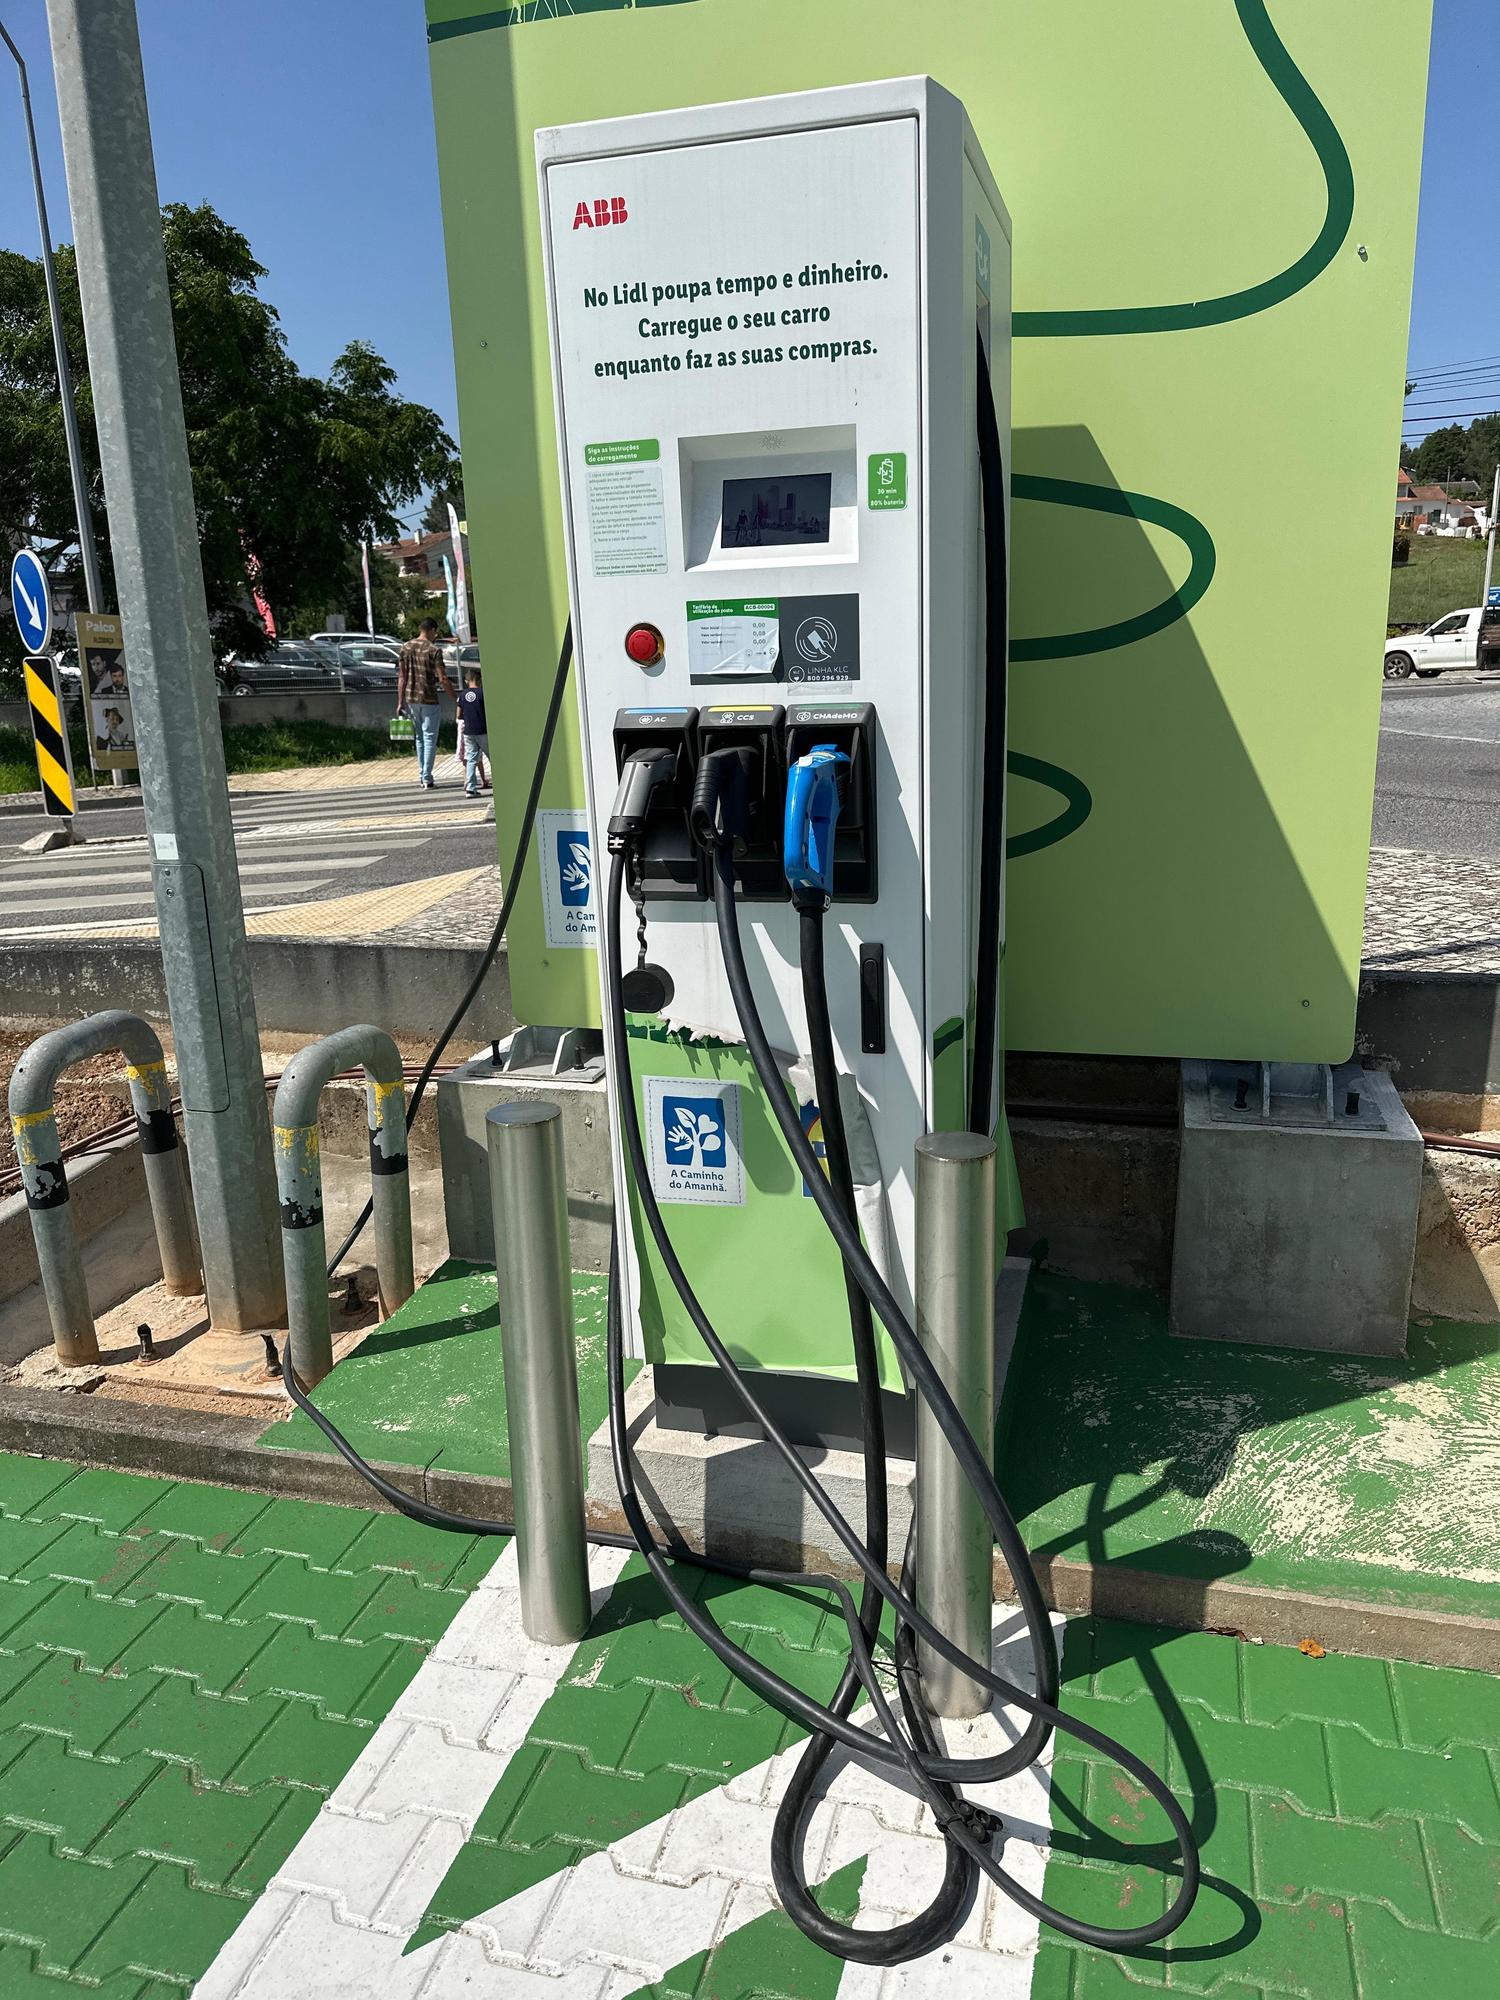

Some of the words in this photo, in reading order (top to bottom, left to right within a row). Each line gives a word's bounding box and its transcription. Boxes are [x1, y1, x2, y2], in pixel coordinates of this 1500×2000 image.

[572, 196, 629, 231] ABB
[583, 287, 609, 308] No
[613, 281, 648, 305] Lidl
[651, 281, 712, 307] poupa
[715, 272, 778, 297] tempo
[782, 273, 793, 289] e
[798, 259, 889, 287] dinheiro.
[638, 314, 723, 340] Carregue
[727, 314, 738, 330] o
[743, 311, 776, 329] seu
[780, 306, 831, 326] carro
[594, 354, 681, 381] enquanto
[685, 348, 713, 370] faz
[717, 350, 737, 367] as
[741, 346, 784, 365] suas
[788, 339, 878, 363] compras.
[588, 447, 600, 455] Siga
[609, 444, 640, 452] instruções
[597, 453, 638, 461] carregamento
[883, 498, 904, 506] bateria
[86, 620, 116, 633] Palco
[807, 667, 833, 675] LINHA
[833, 665, 849, 673] KLC
[812, 712, 858, 720] CHAdeMO
[566, 910, 574, 920] A
[565, 922, 578, 933] do
[670, 1169, 678, 1178] A
[680, 1169, 724, 1181] Caminho
[669, 1180, 682, 1189] do
[684, 1180, 727, 1192] Amanhã.
